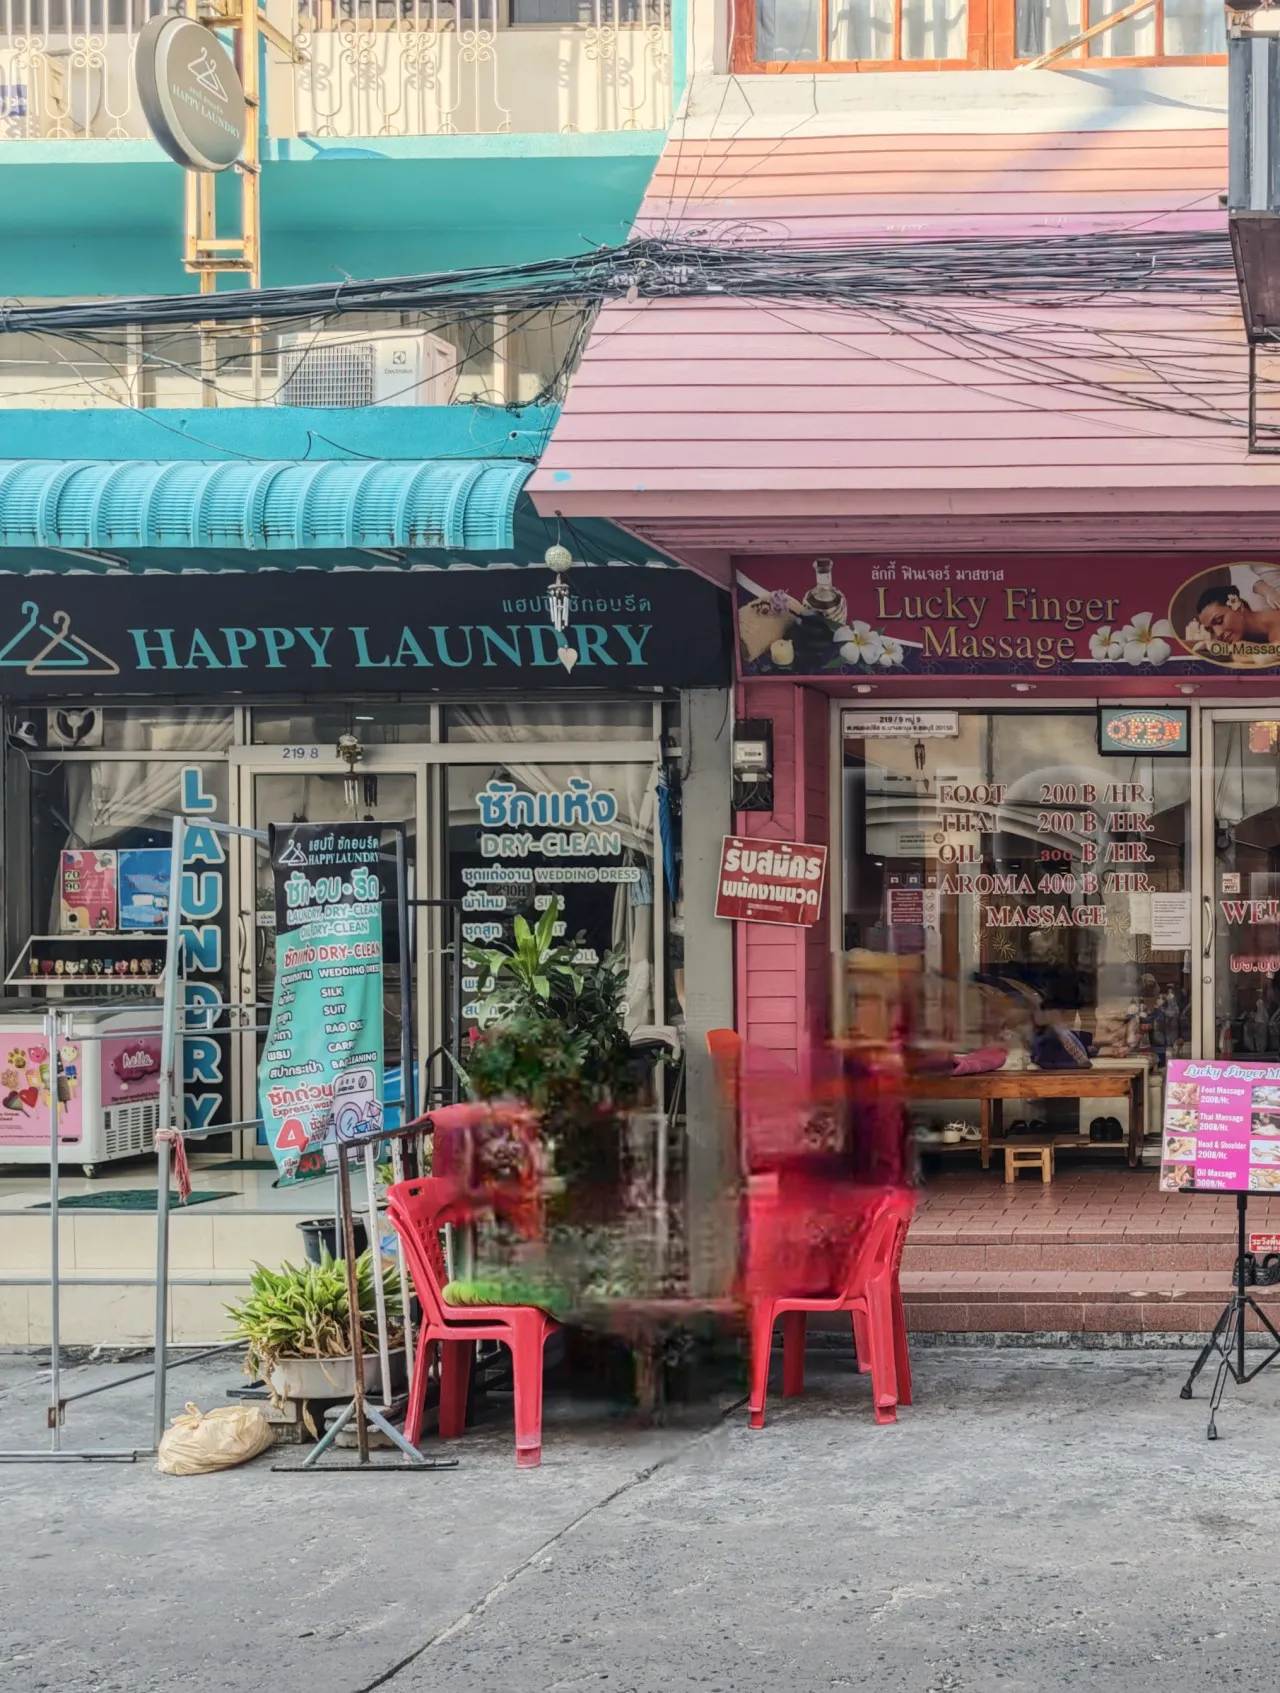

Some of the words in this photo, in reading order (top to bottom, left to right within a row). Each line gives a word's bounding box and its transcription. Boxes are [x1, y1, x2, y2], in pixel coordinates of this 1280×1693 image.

[172, 84, 200, 112] HAPPY
[201, 105, 241, 139] LAUNDRY
[875, 586, 988, 629] Lucky
[1003, 587, 1120, 631] Finger
[127, 626, 334, 670] HAPPY
[348, 624, 653, 669] LAUNDRY
[921, 625, 1076, 669] Massage
[1210, 642, 1229, 655] Oil
[1106, 719, 1182, 741] OPEN
[283, 747, 305, 759] 219
[310, 747, 319, 759] 8
[476, 776, 619, 828] ซักแห้ง
[938, 783, 1008, 805] FOOT
[1039, 783, 1077, 805] 200
[940, 812, 1001, 833] THAI
[1037, 812, 1076, 833] 200
[481, 832, 622, 857] DRY-CLEAN
[938, 843, 984, 864] OIL
[1040, 850, 1073, 862] 300
[309, 853, 334, 866] HAPPY
[335, 852, 380, 864] LAUNDRY
[724, 839, 822, 881] รับสมัคร
[65, 870, 80, 880] 70
[462, 863, 533, 888] ชุดแต่งงาน
[534, 867, 598, 883] WEDDING
[599, 867, 641, 883] DRESS
[938, 873, 1035, 895] AROMA
[1038, 873, 1076, 895] 400
[65, 882, 80, 893] 90
[721, 876, 819, 906] พนักงานนวด
[324, 901, 380, 920] DRY-CLEAN
[462, 891, 506, 911] ผ้าไหม
[534, 895, 565, 912] SIK
[986, 905, 1108, 927] MASSAGE
[180, 767, 226, 1142] LAUNDRY
[318, 941, 380, 961] DRY-CLEAN
[318, 965, 365, 979] WEDDING
[320, 986, 345, 999] SILK
[322, 1004, 347, 1017] SUIT
[325, 1022, 348, 1034] RAG
[267, 1049, 292, 1061] พรม
[327, 1040, 357, 1053] CARP
[1183, 1065, 1222, 1081] Lucky
[1223, 1065, 1266, 1082] Finger
[267, 1081, 334, 1107] ซักด่วน
[1201, 1086, 1216, 1095] Foot
[1216, 1086, 1245, 1096] Massage
[272, 1104, 312, 1118] Express
[1199, 1113, 1214, 1121] Thai
[1215, 1113, 1244, 1123] Massage
[275, 1118, 310, 1153] 4
[1197, 1168, 1205, 1177] Oil
[1205, 1169, 1237, 1179] Massage
